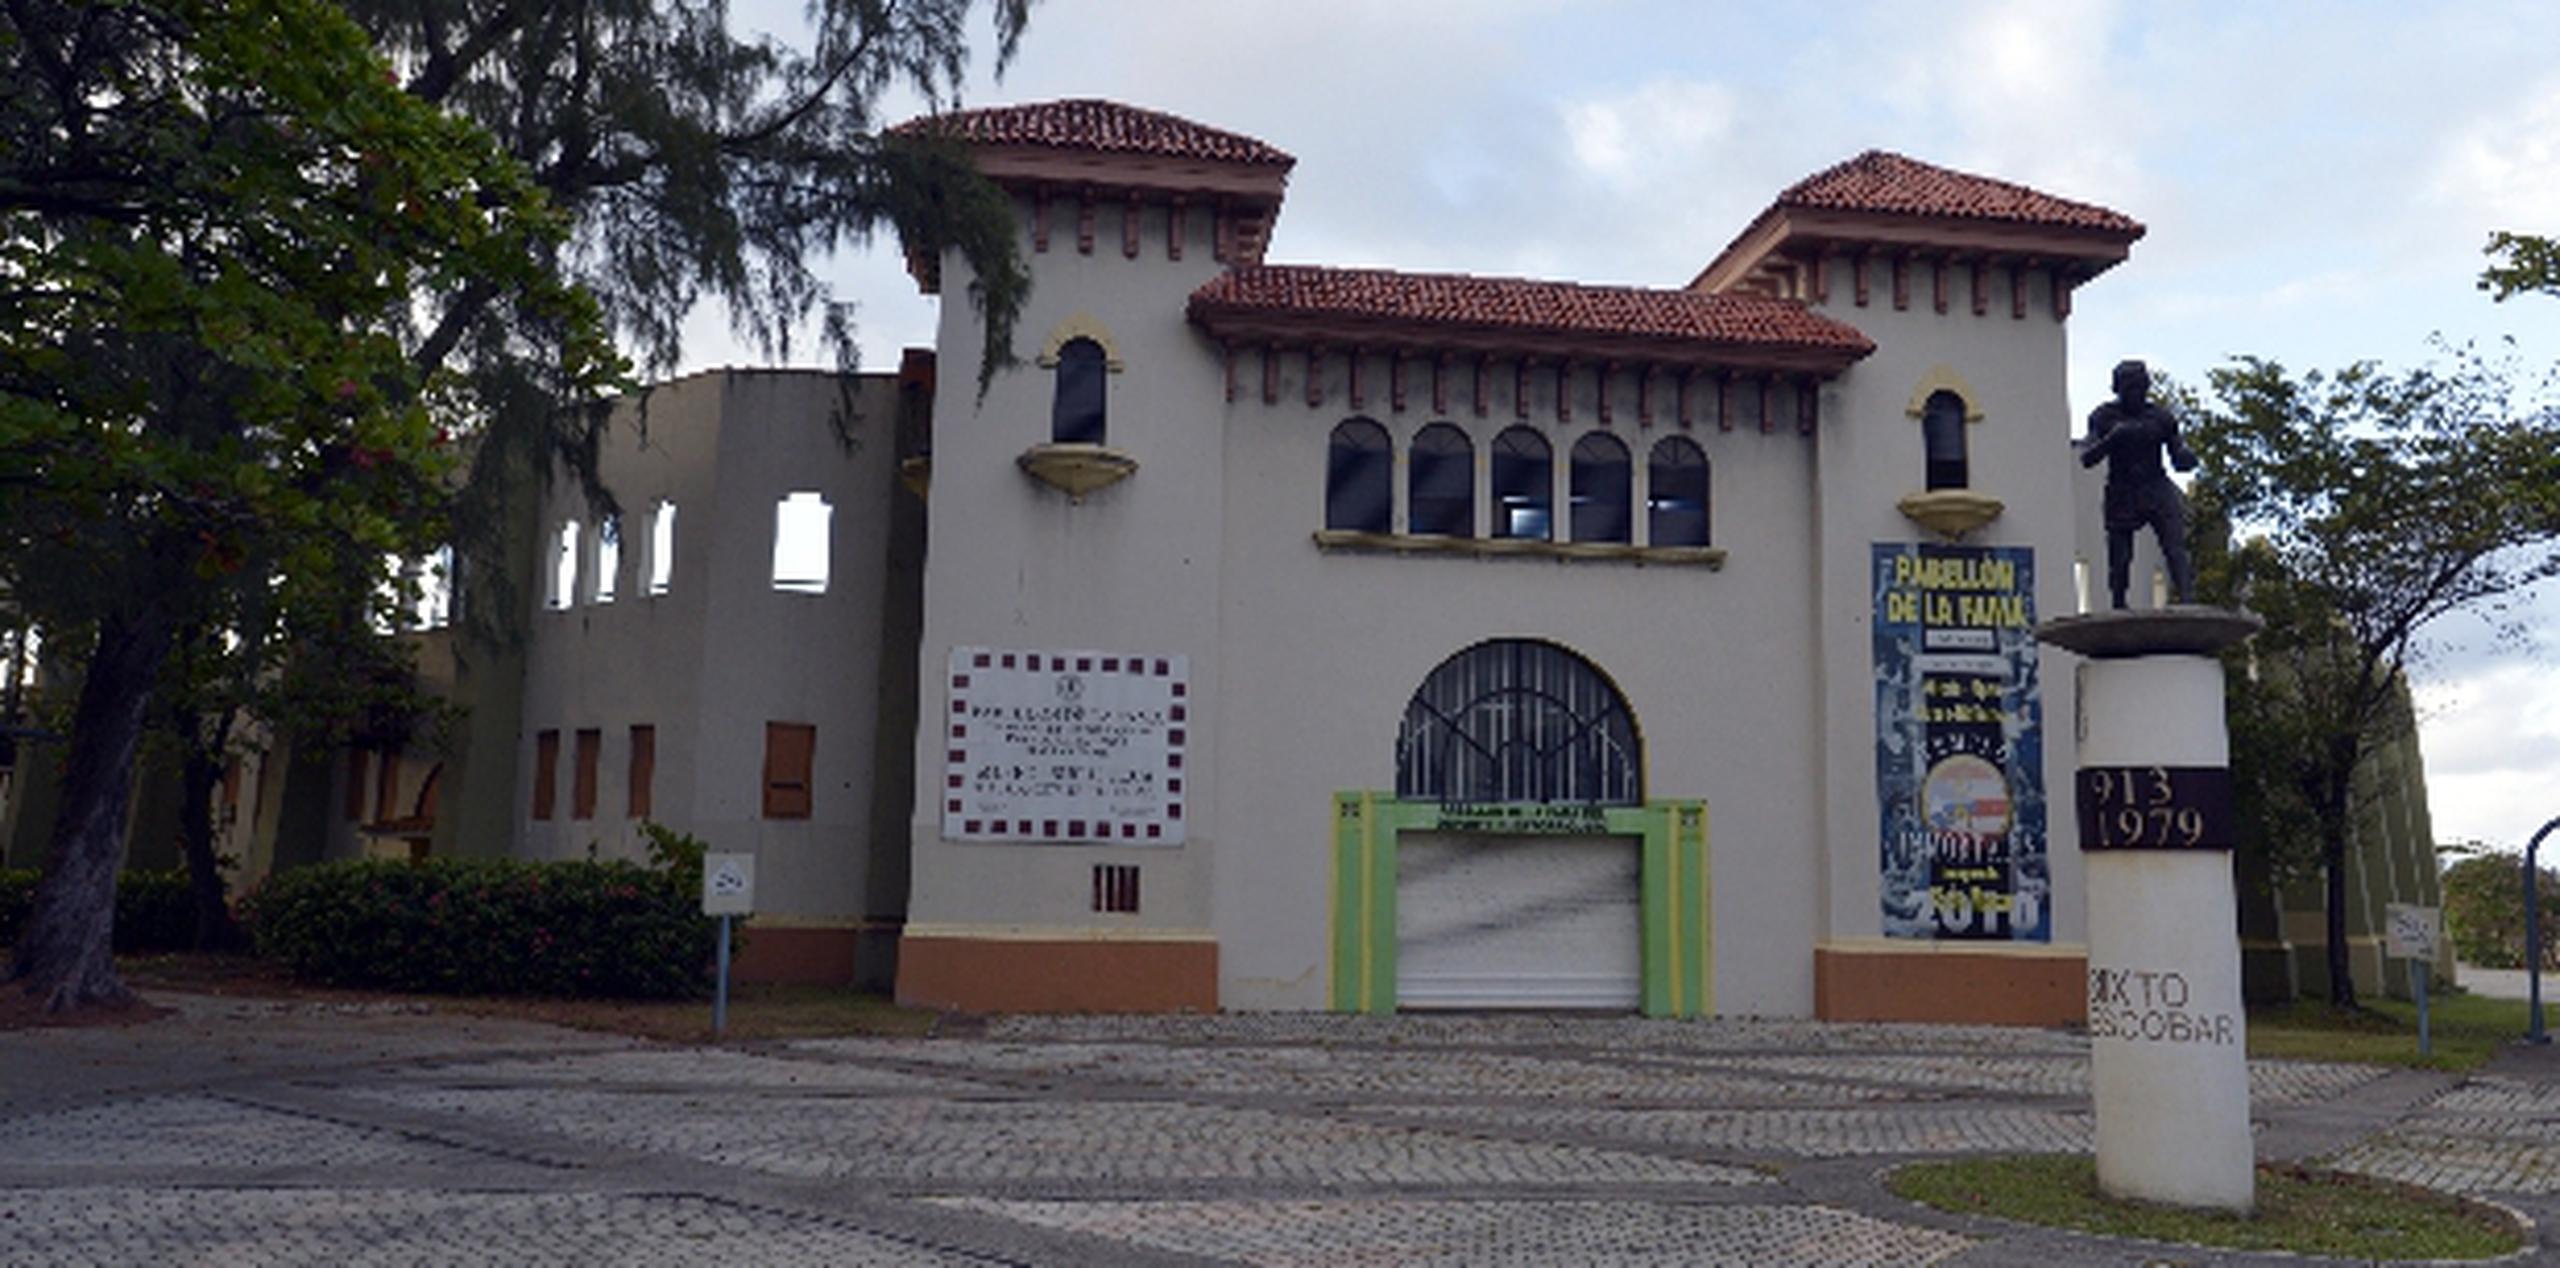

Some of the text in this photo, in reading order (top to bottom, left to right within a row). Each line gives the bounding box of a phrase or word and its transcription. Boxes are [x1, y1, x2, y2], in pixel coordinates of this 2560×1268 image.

[1888, 593, 2028, 630] DE LA FAMA
[2098, 807, 2204, 847] 1979
[2091, 1008, 2234, 1045] ESCOBAR
